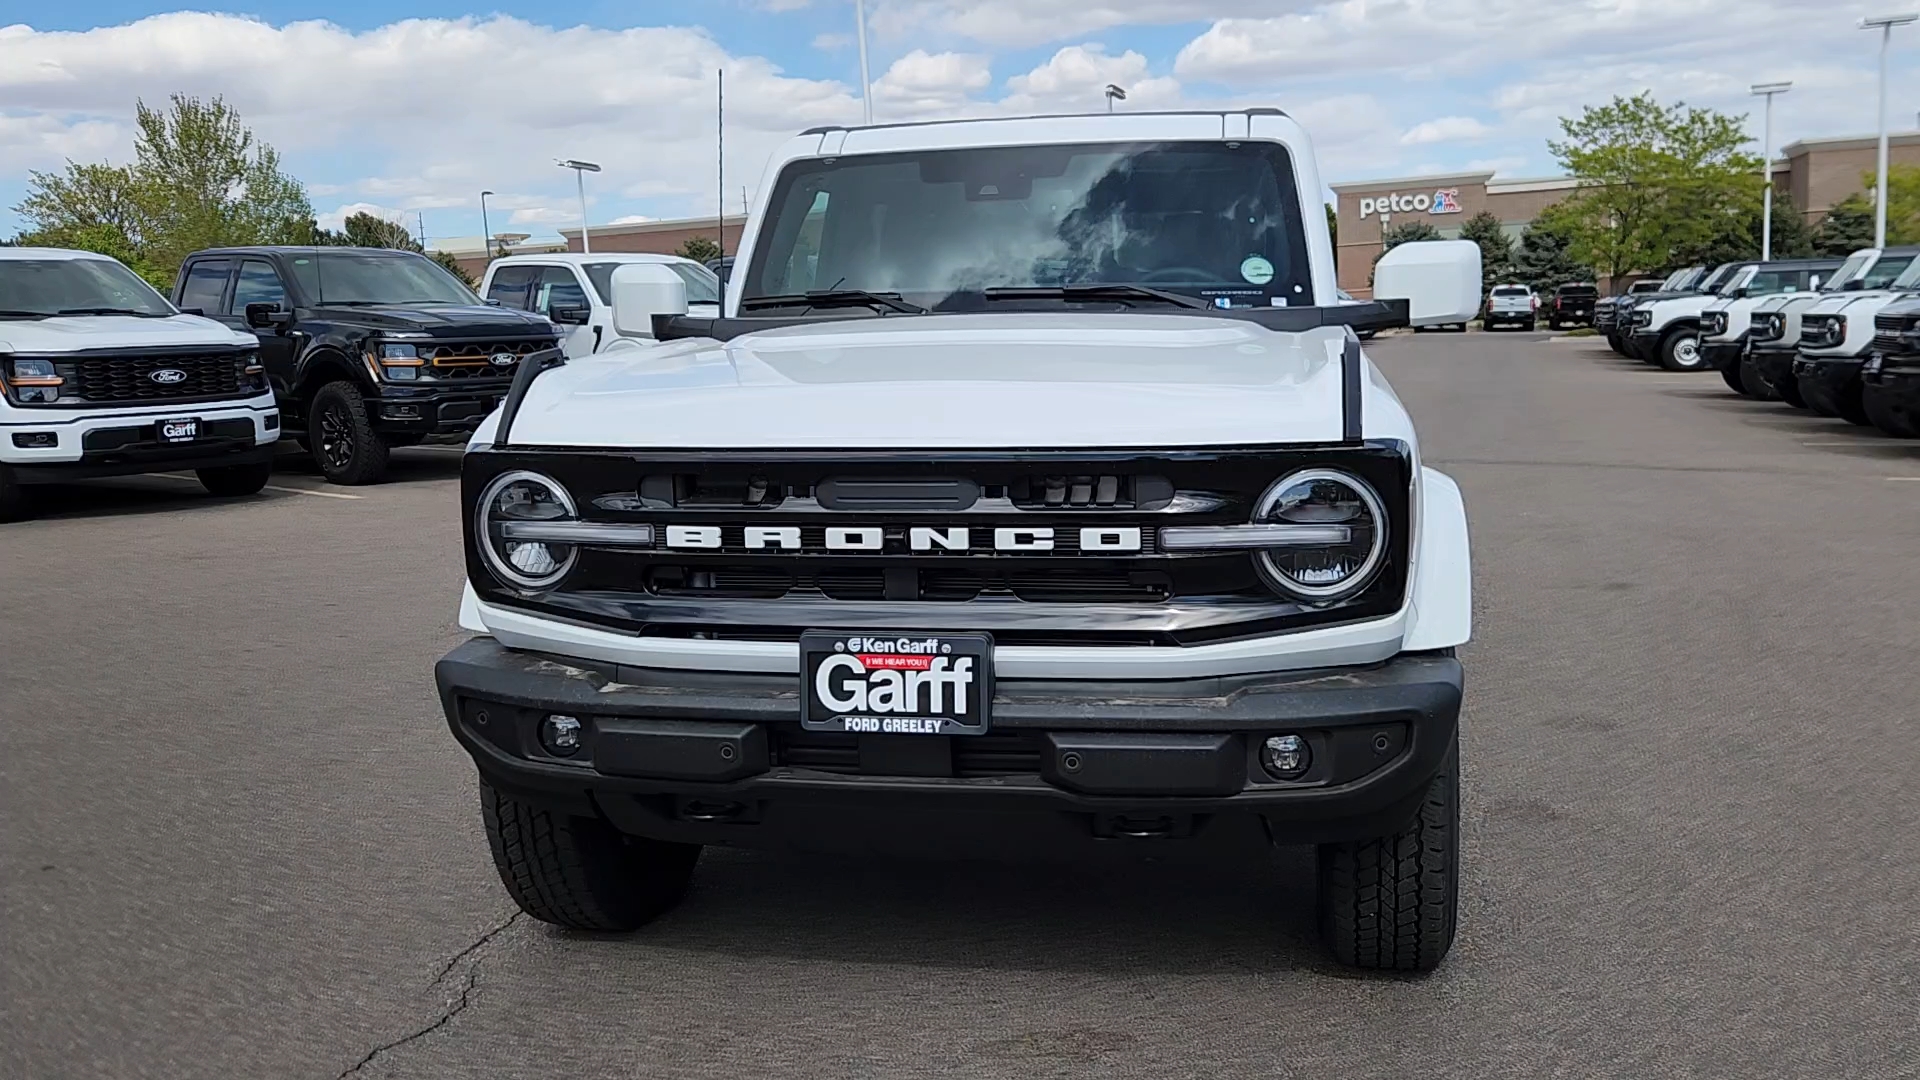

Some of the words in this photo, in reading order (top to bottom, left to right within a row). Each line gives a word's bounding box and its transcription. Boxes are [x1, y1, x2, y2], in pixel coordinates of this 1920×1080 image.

[1360, 192, 1430, 219] petco
[163, 423, 196, 437] Garff
[665, 525, 1141, 550] BRONCO
[862, 638, 895, 653] Ken
[896, 638, 939, 654] Garff
[871, 657, 884, 666] WE
[885, 657, 906, 666] HEAR
[906, 658, 922, 667] YOU
[815, 653, 973, 715] Garff
[845, 717, 880, 732] FORD
[882, 718, 942, 733] GREELEY
